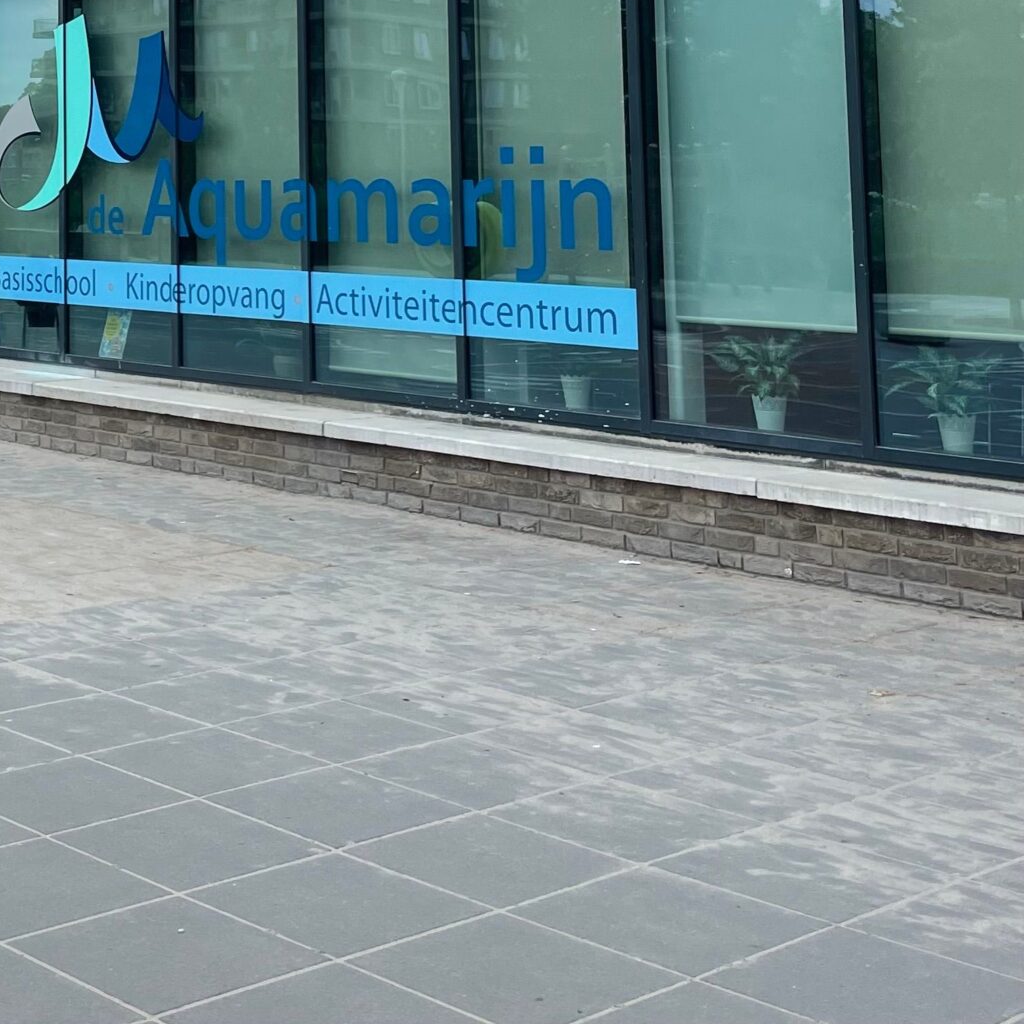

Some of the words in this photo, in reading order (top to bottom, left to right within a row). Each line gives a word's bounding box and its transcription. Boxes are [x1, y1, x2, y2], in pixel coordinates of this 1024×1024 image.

[87, 193, 124, 235] de
[141, 145, 614, 283] Aquamarijn
[126, 272, 287, 319] Kinderopvang
[316, 283, 617, 336] Activiteitencentrum
